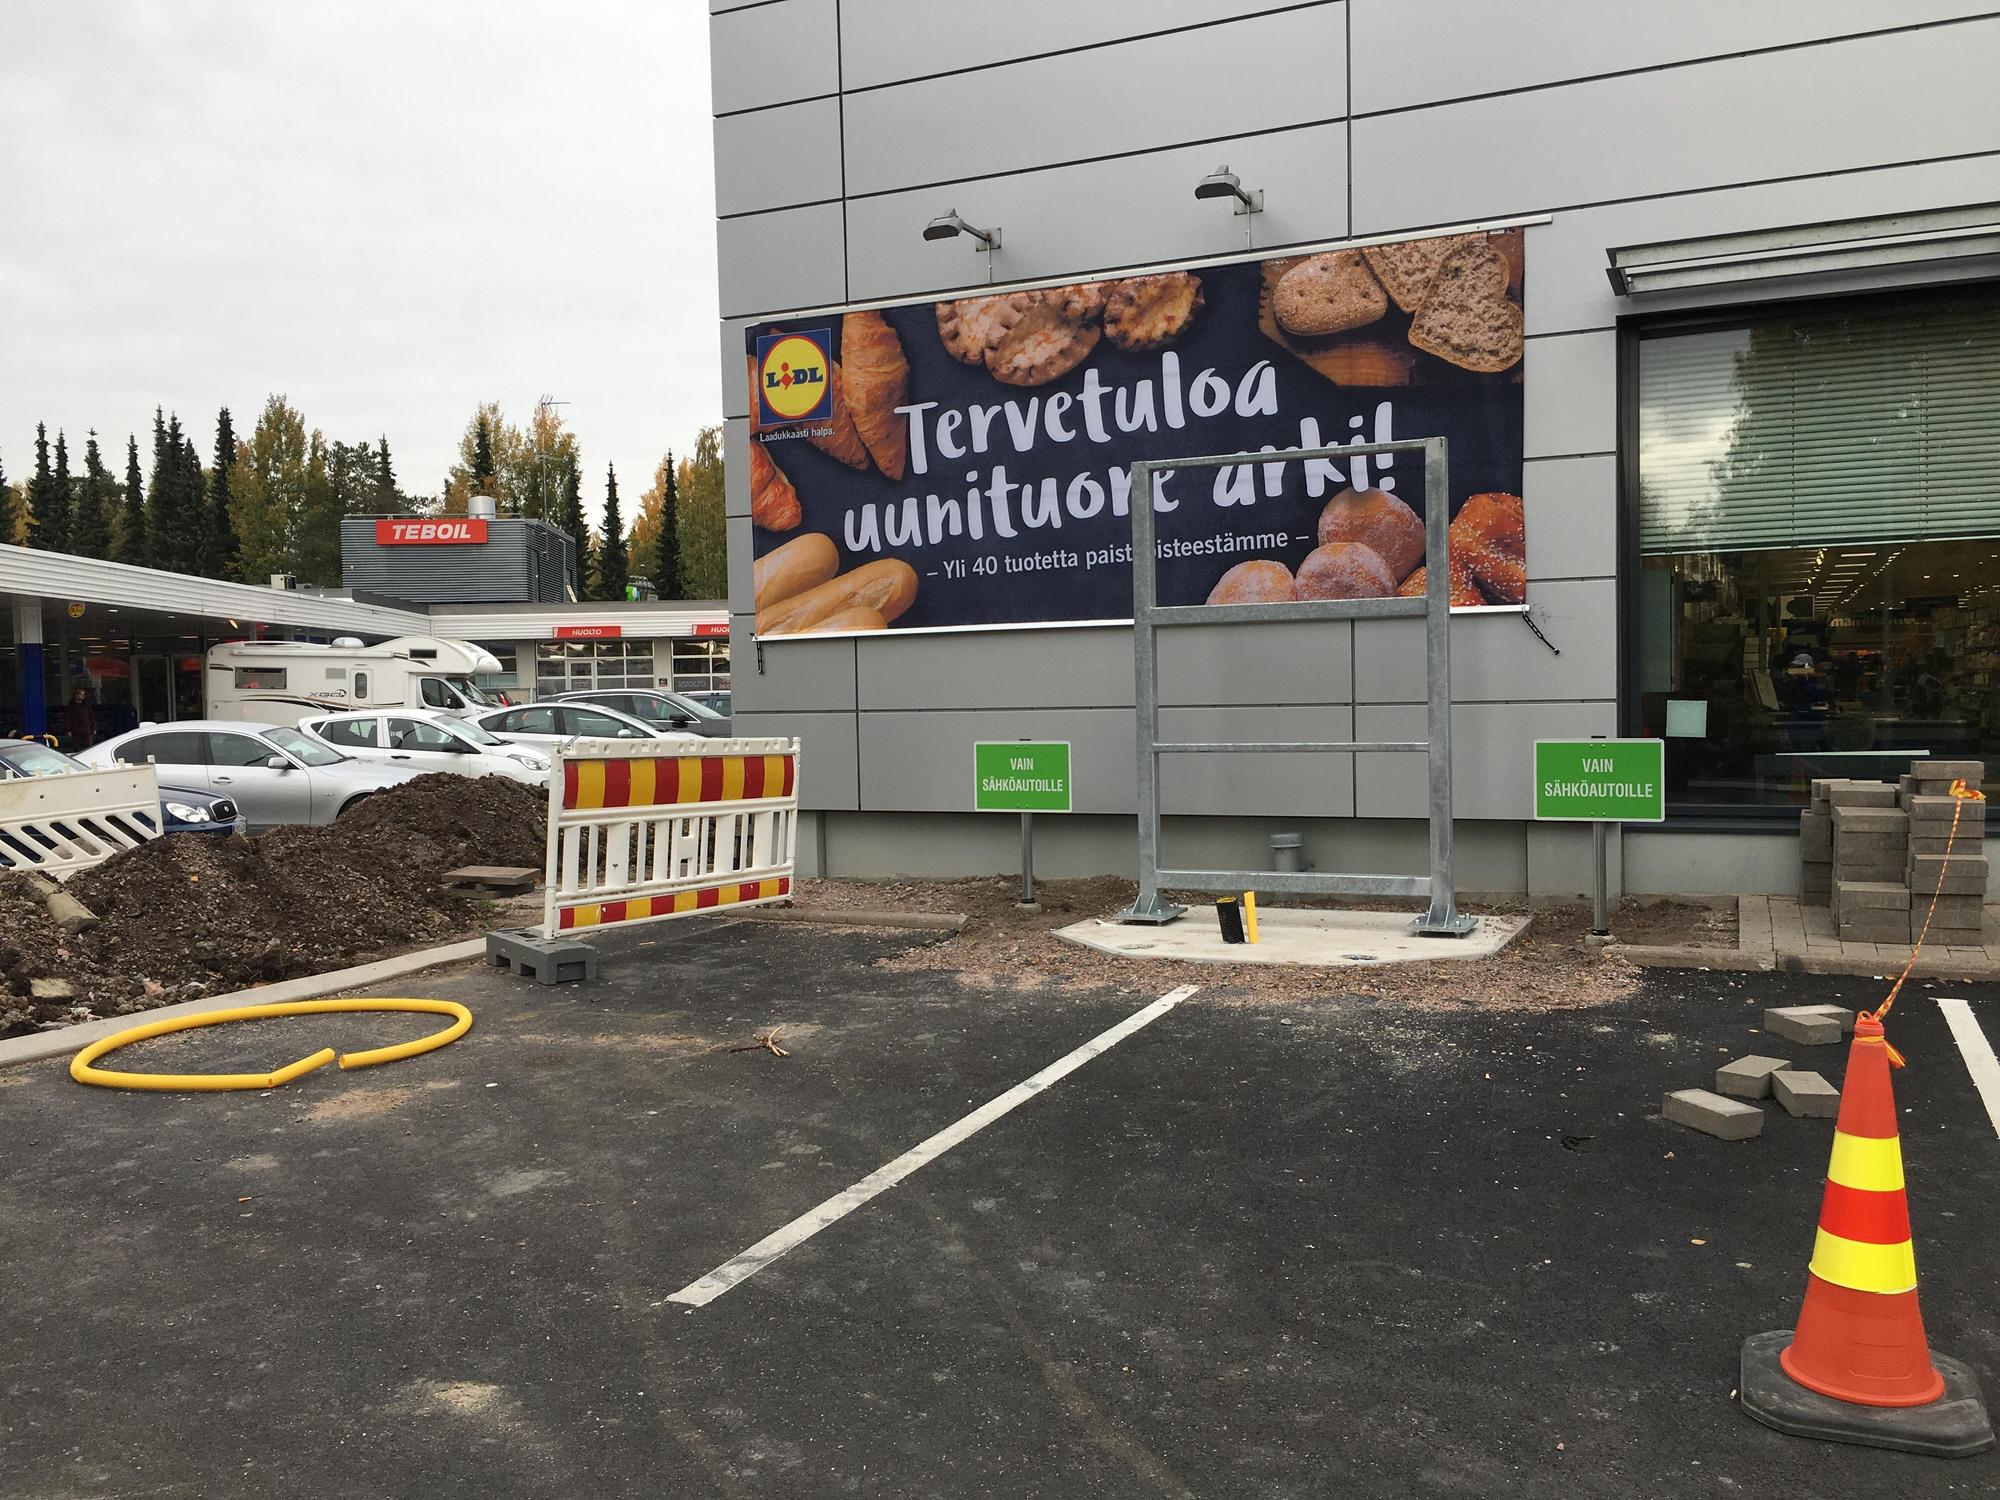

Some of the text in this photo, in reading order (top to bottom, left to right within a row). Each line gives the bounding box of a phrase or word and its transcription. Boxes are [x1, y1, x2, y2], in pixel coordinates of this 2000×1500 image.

[894, 351, 1279, 475] Tervetuloa
[760, 427, 835, 442] Laadukkaasti halpa.
[844, 402, 1396, 553] uunituore arki!
[392, 524, 471, 540] TEBOIL
[943, 559, 965, 579] Yli
[972, 555, 998, 576] 40
[1004, 549, 1078, 573] tuotetta
[1086, 532, 1288, 569] paististeestämme
[572, 628, 602, 636] HUOLTO
[1010, 757, 1034, 771] VAIN
[1582, 758, 1613, 773] VAIN
[982, 776, 1064, 792] SÄHKÖAUTOILLE
[1544, 779, 1653, 798] SÄHKÖAUTOILLE
